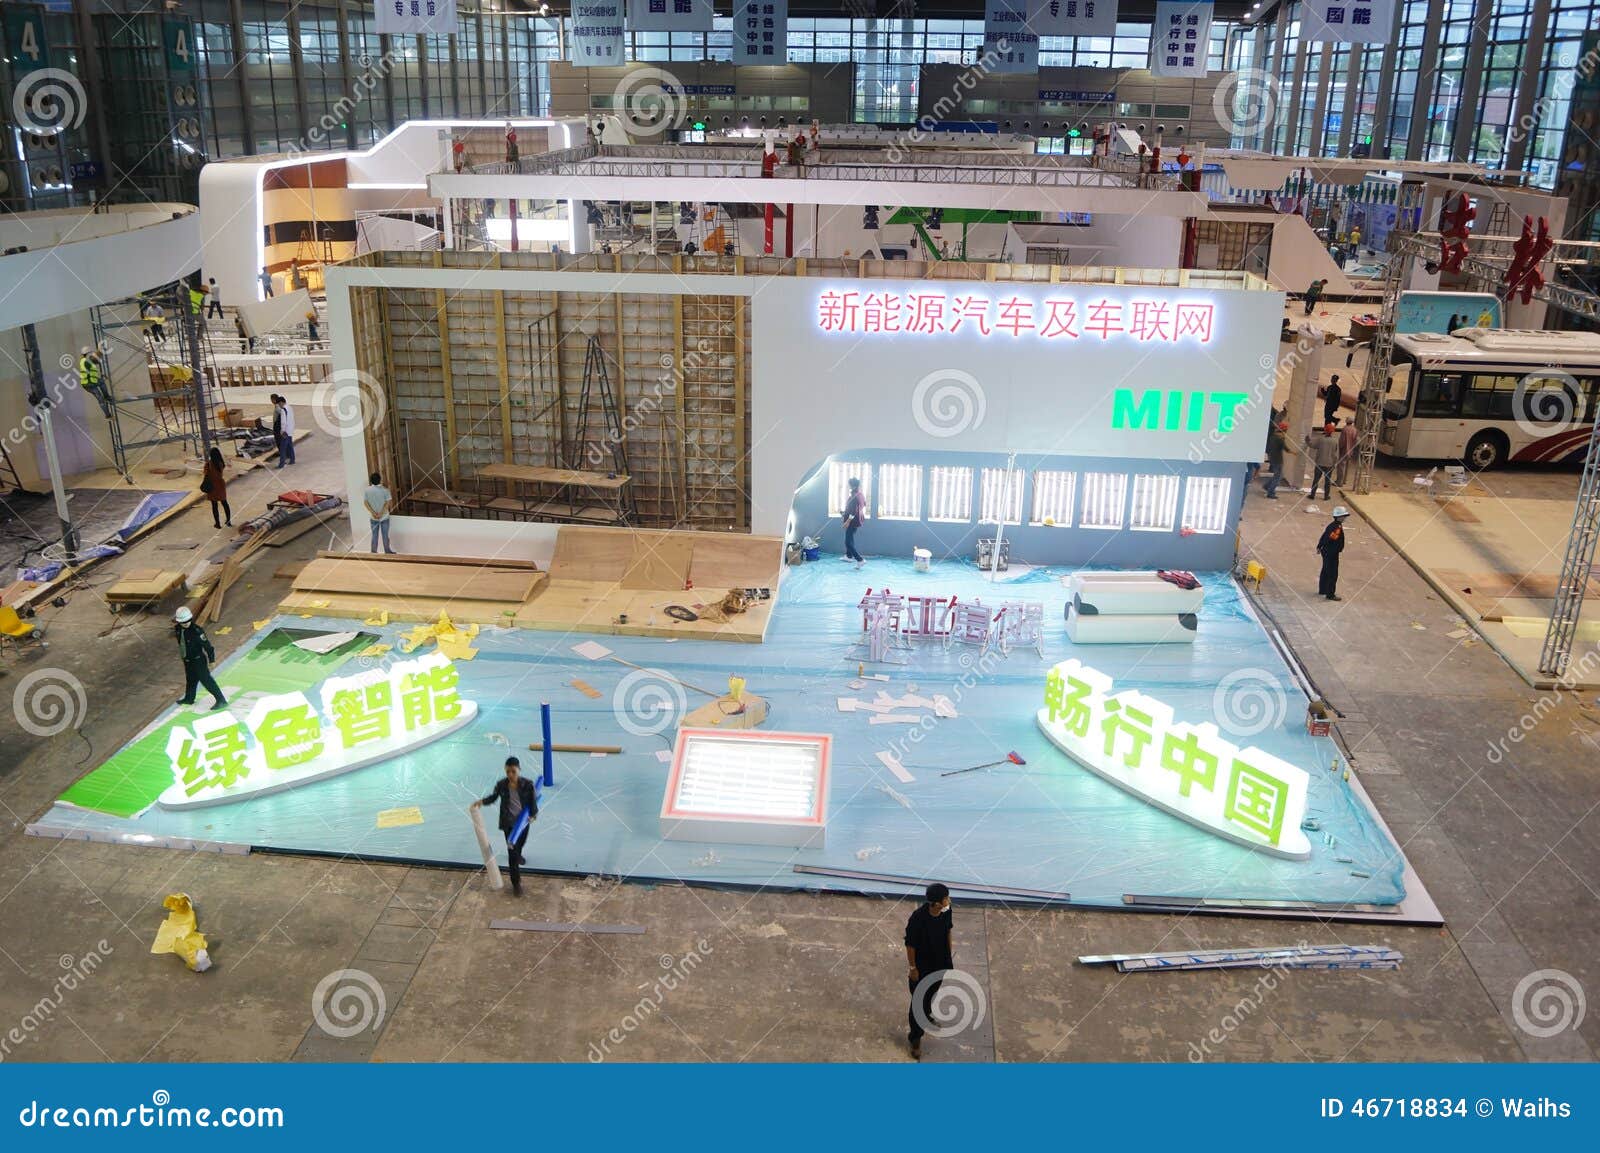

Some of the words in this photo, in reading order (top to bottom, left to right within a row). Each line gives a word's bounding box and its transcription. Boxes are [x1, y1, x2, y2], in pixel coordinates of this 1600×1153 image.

[395, 0, 435, 16] 专题馆
[1050, 0, 1095, 18] 专题馆
[21, 21, 39, 61] 4
[176, 29, 189, 63] 4
[1166, 14, 1182, 66] 畅行中国
[1183, 14, 1199, 66] 绿色智能
[818, 290, 1215, 343] 新能源汽车及车联网
[1111, 388, 1249, 433] MIIT
[176, 663, 463, 798] 绿色智能
[1043, 663, 1291, 848] 畅行中国
